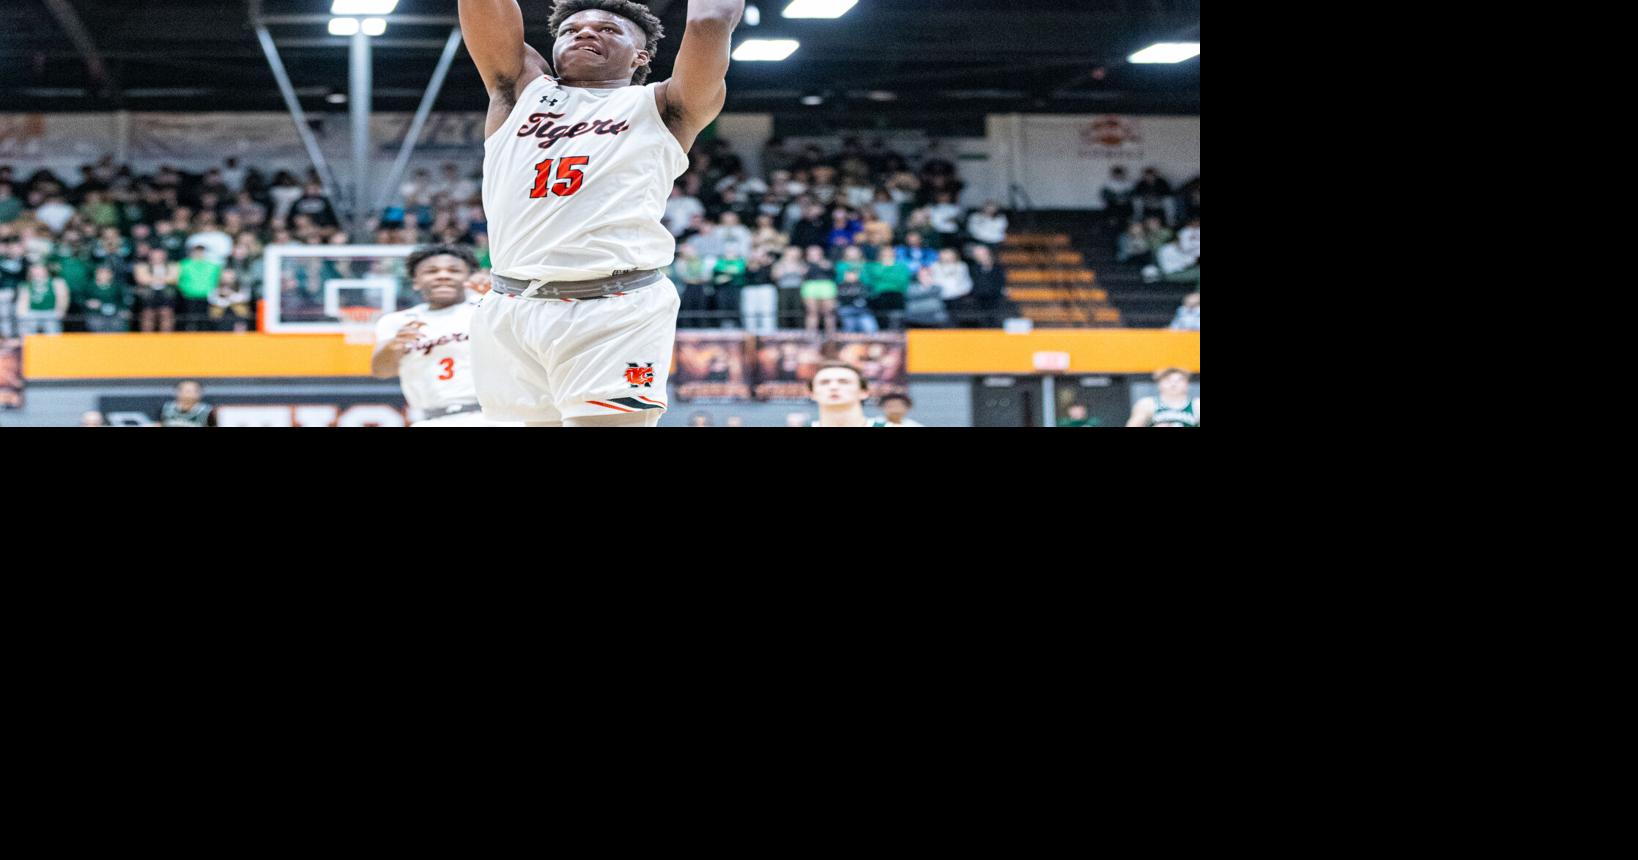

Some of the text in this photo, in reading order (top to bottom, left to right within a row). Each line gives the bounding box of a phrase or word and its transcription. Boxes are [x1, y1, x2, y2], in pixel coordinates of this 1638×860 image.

[516, 112, 630, 149] Tigers
[530, 155, 589, 199] 15
[438, 357, 455, 380] 3
